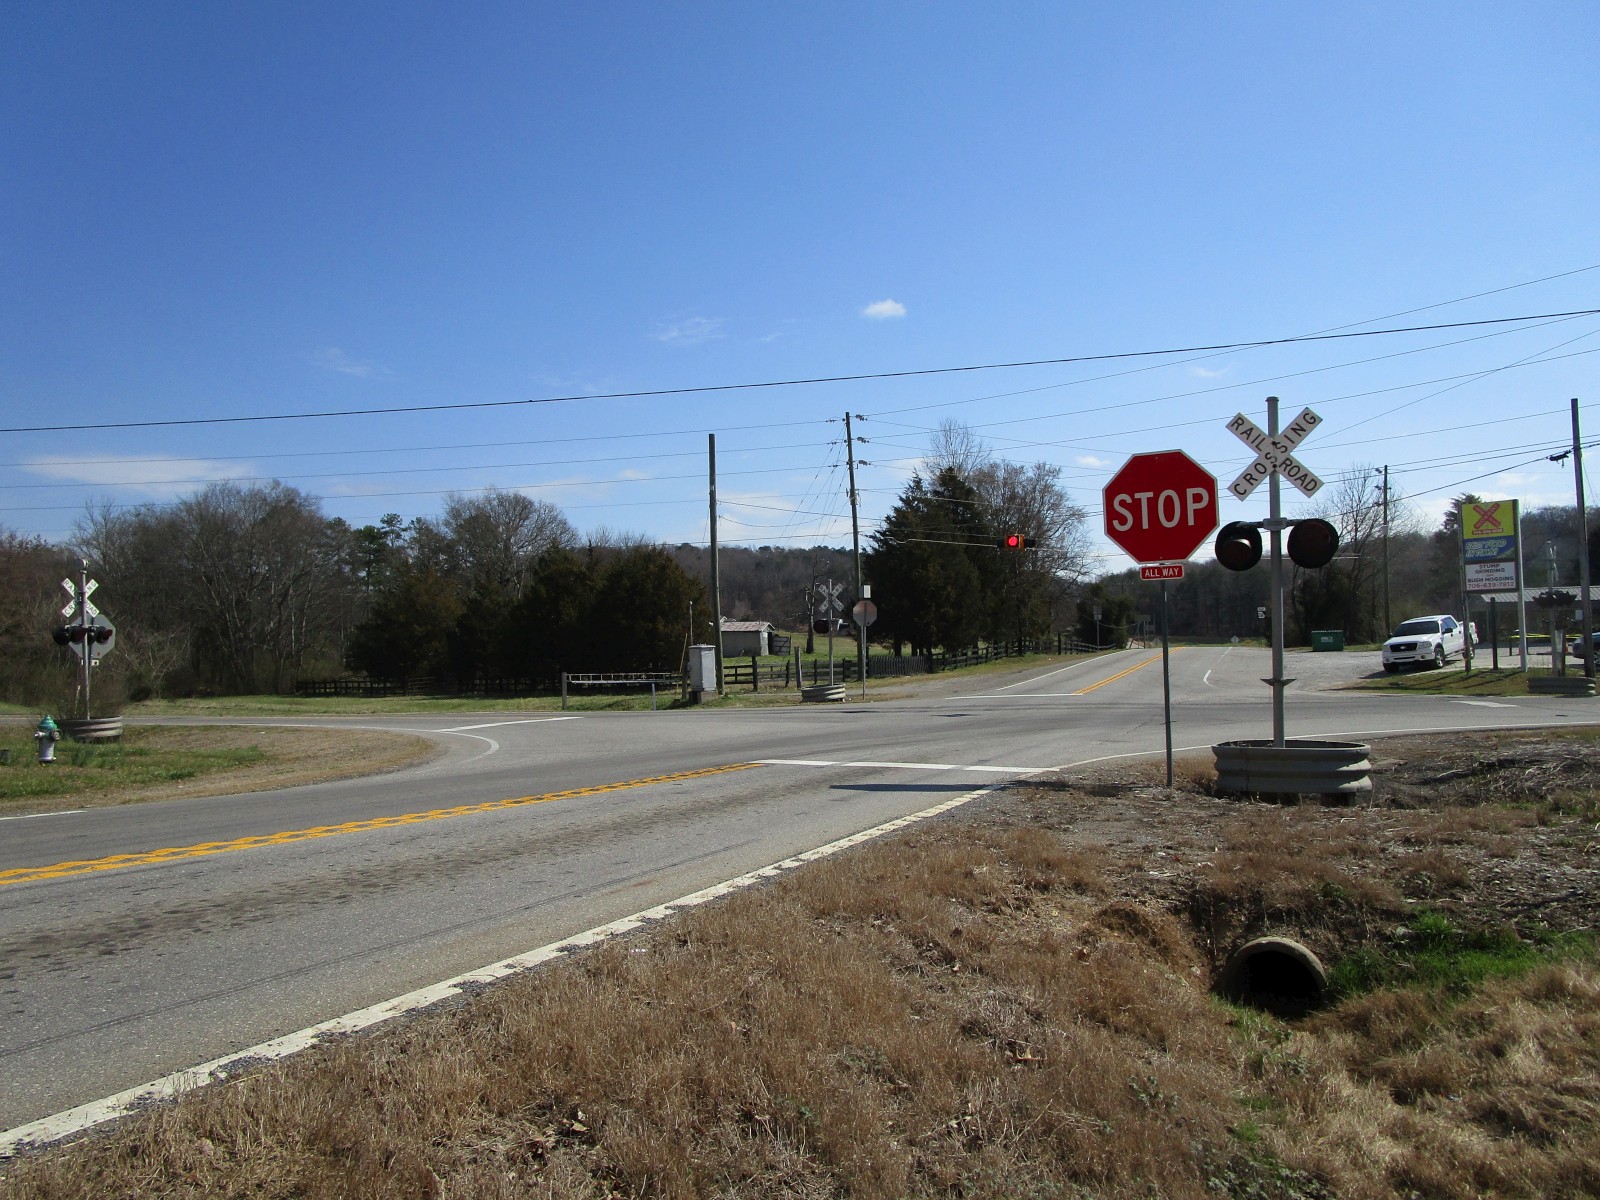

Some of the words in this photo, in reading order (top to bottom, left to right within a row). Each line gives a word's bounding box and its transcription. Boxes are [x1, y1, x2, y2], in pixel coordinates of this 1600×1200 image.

[1230, 416, 1266, 452] RAIL
[1278, 457, 1318, 492] ROAD
[1233, 412, 1317, 496] CROSSING
[1112, 487, 1210, 532] STOP
[1144, 568, 1160, 577] ALL
[1162, 567, 1179, 576] WAY
